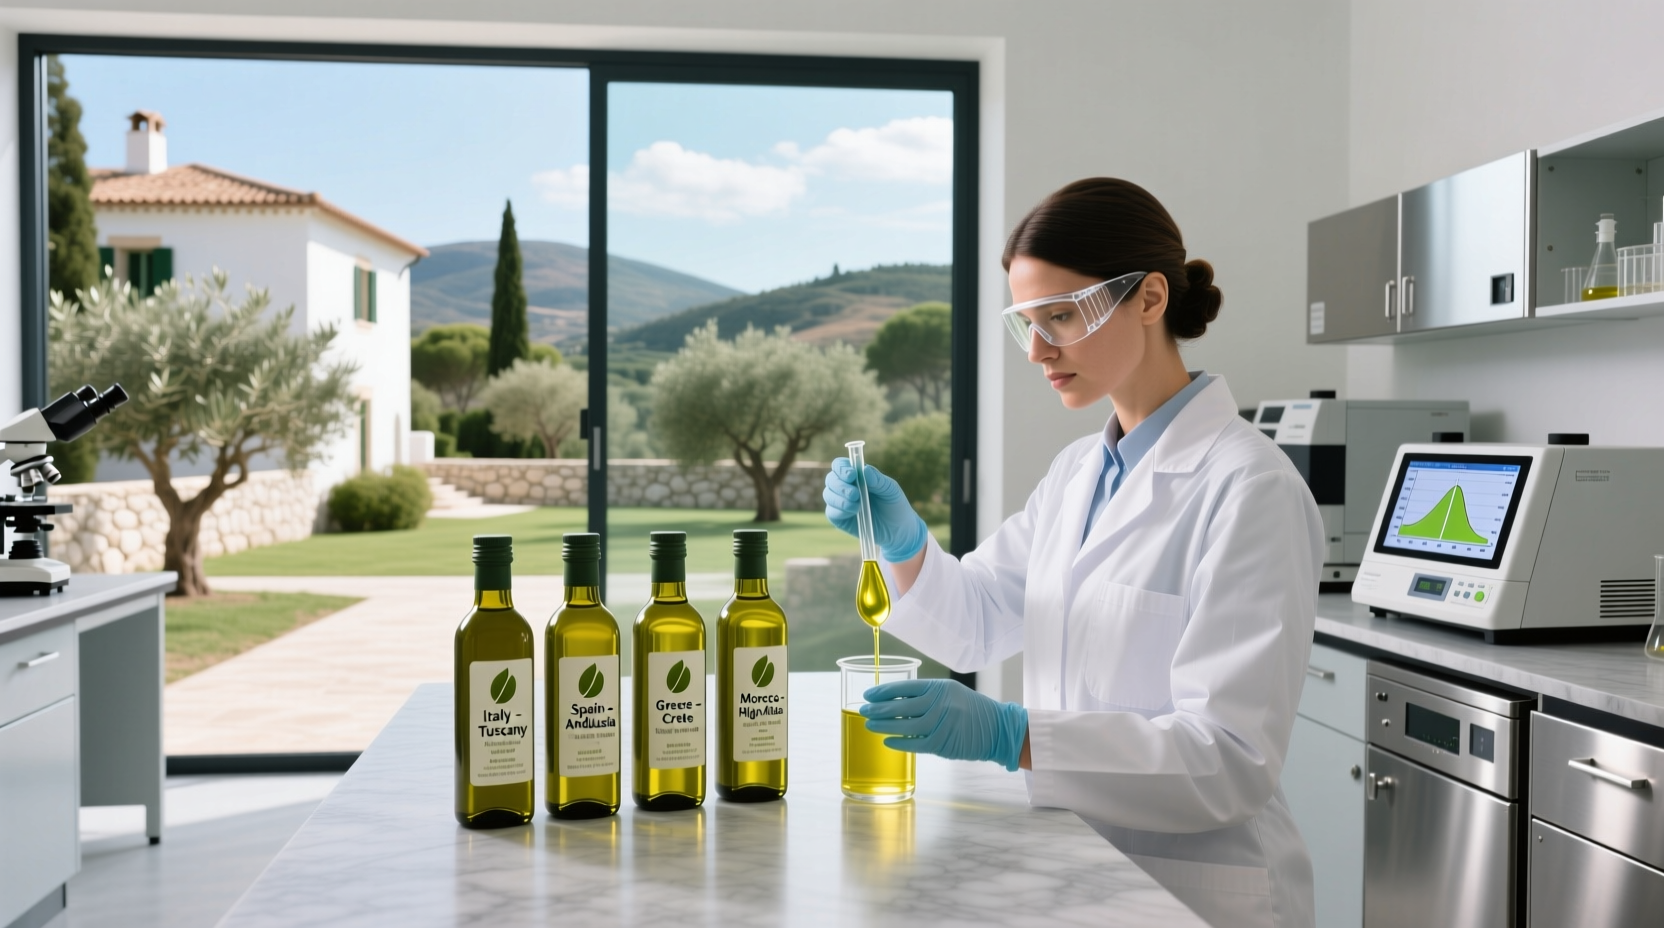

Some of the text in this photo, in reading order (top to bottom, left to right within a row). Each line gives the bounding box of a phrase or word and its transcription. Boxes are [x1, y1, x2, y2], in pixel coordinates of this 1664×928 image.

[483, 709, 511, 724] Italy
[571, 702, 605, 718] Spain
[478, 725, 527, 738] Tuscany
